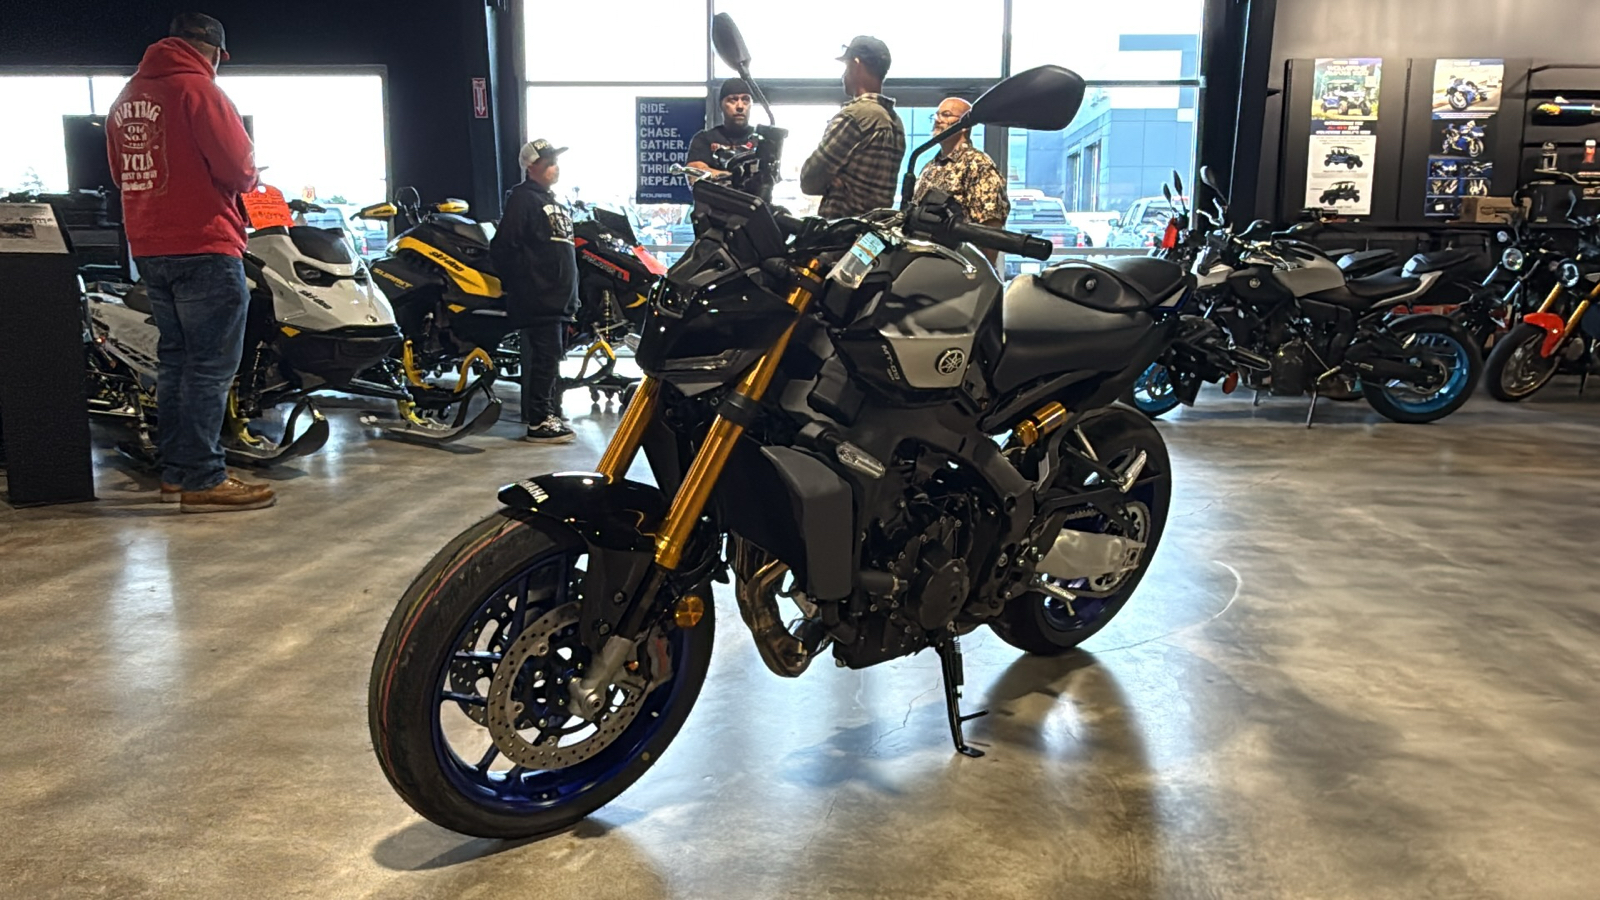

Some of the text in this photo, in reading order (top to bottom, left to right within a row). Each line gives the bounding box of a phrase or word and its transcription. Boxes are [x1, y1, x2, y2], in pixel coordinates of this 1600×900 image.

[640, 103, 669, 114] RIDE.
[640, 115, 665, 126] REV.
[640, 128, 681, 138] CHASE.
[640, 140, 688, 150] GATHER.
[641, 176, 687, 187] REPEAT.
[428, 250, 465, 272] ski-doo
[372, 267, 414, 289] SUMMIT
[298, 289, 333, 310] ski-doo
